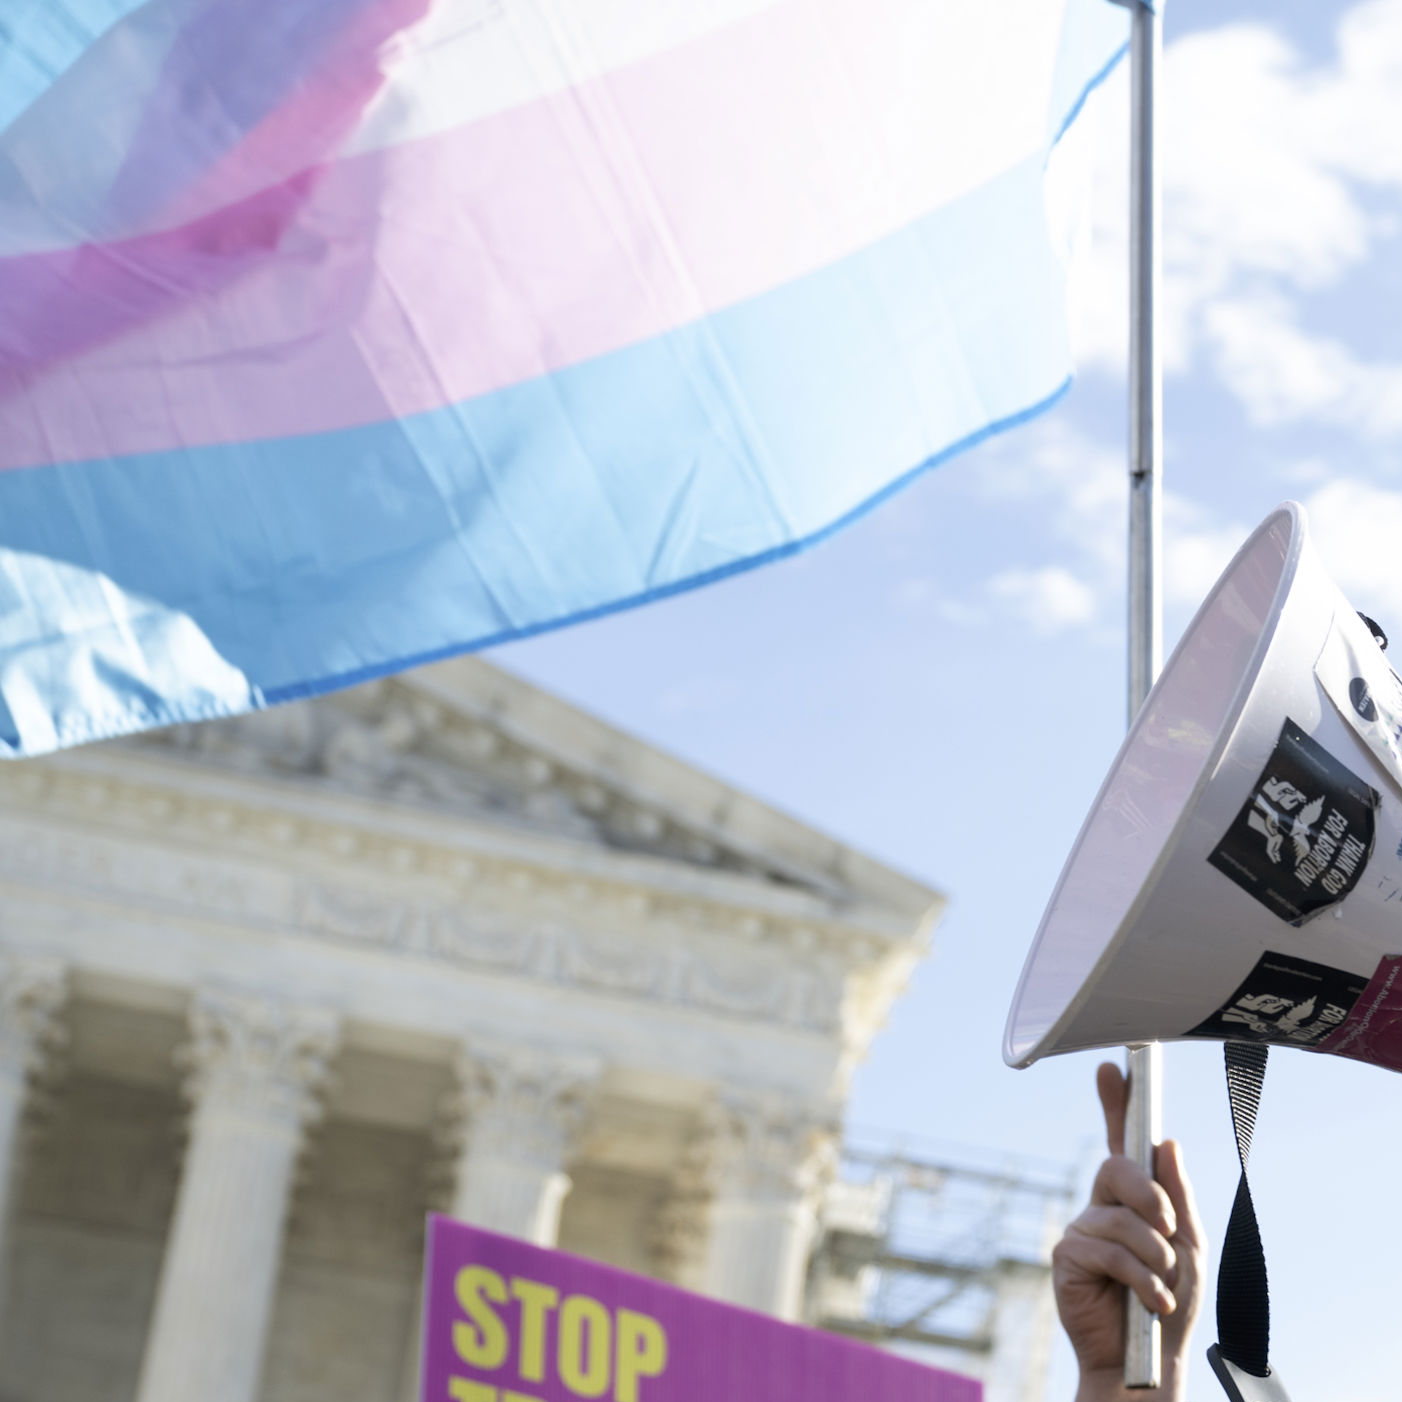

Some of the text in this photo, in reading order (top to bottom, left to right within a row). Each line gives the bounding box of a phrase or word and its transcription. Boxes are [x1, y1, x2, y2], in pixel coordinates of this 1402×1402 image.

[1294, 808, 1349, 887] FOR ABORTION
[1335, 833, 1366, 877] THANK
[1321, 871, 1347, 895] GOD
